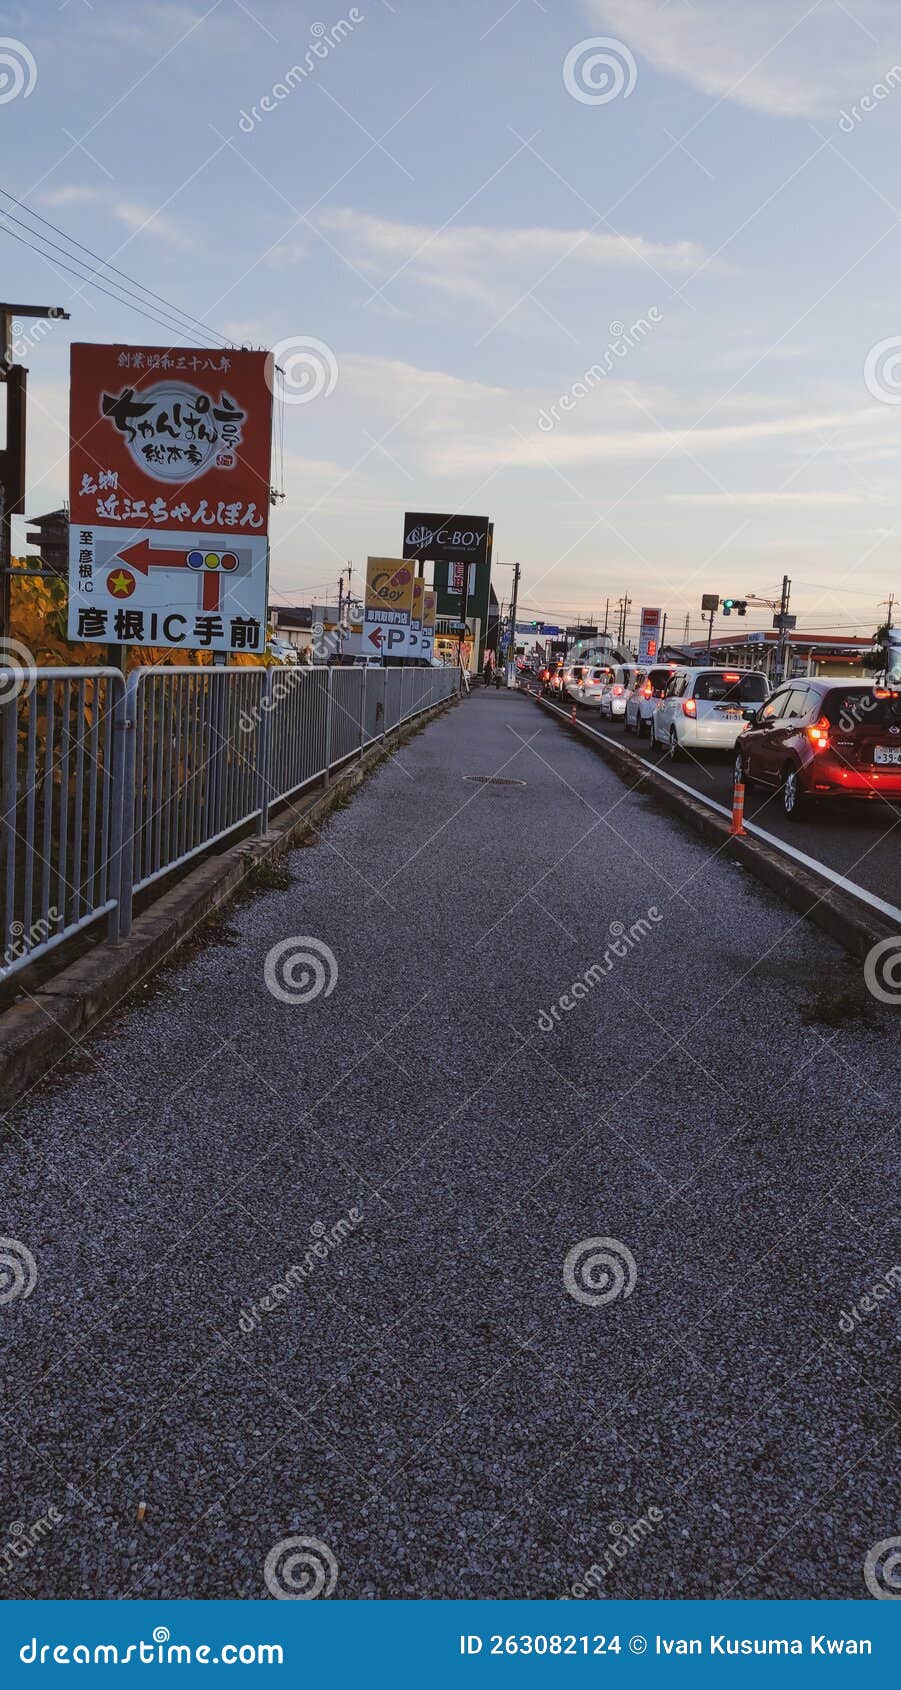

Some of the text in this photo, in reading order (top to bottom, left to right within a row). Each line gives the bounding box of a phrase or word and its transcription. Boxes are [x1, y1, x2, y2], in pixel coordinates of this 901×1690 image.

[117, 352, 231, 373] 創業昭和三十八年
[79, 470, 119, 496] 名物
[96, 494, 263, 528] 近江ちゃんぽん
[436, 531, 485, 546] C-BOY
[77, 607, 262, 649] 彦根IC手前
[387, 629, 405, 649] P
